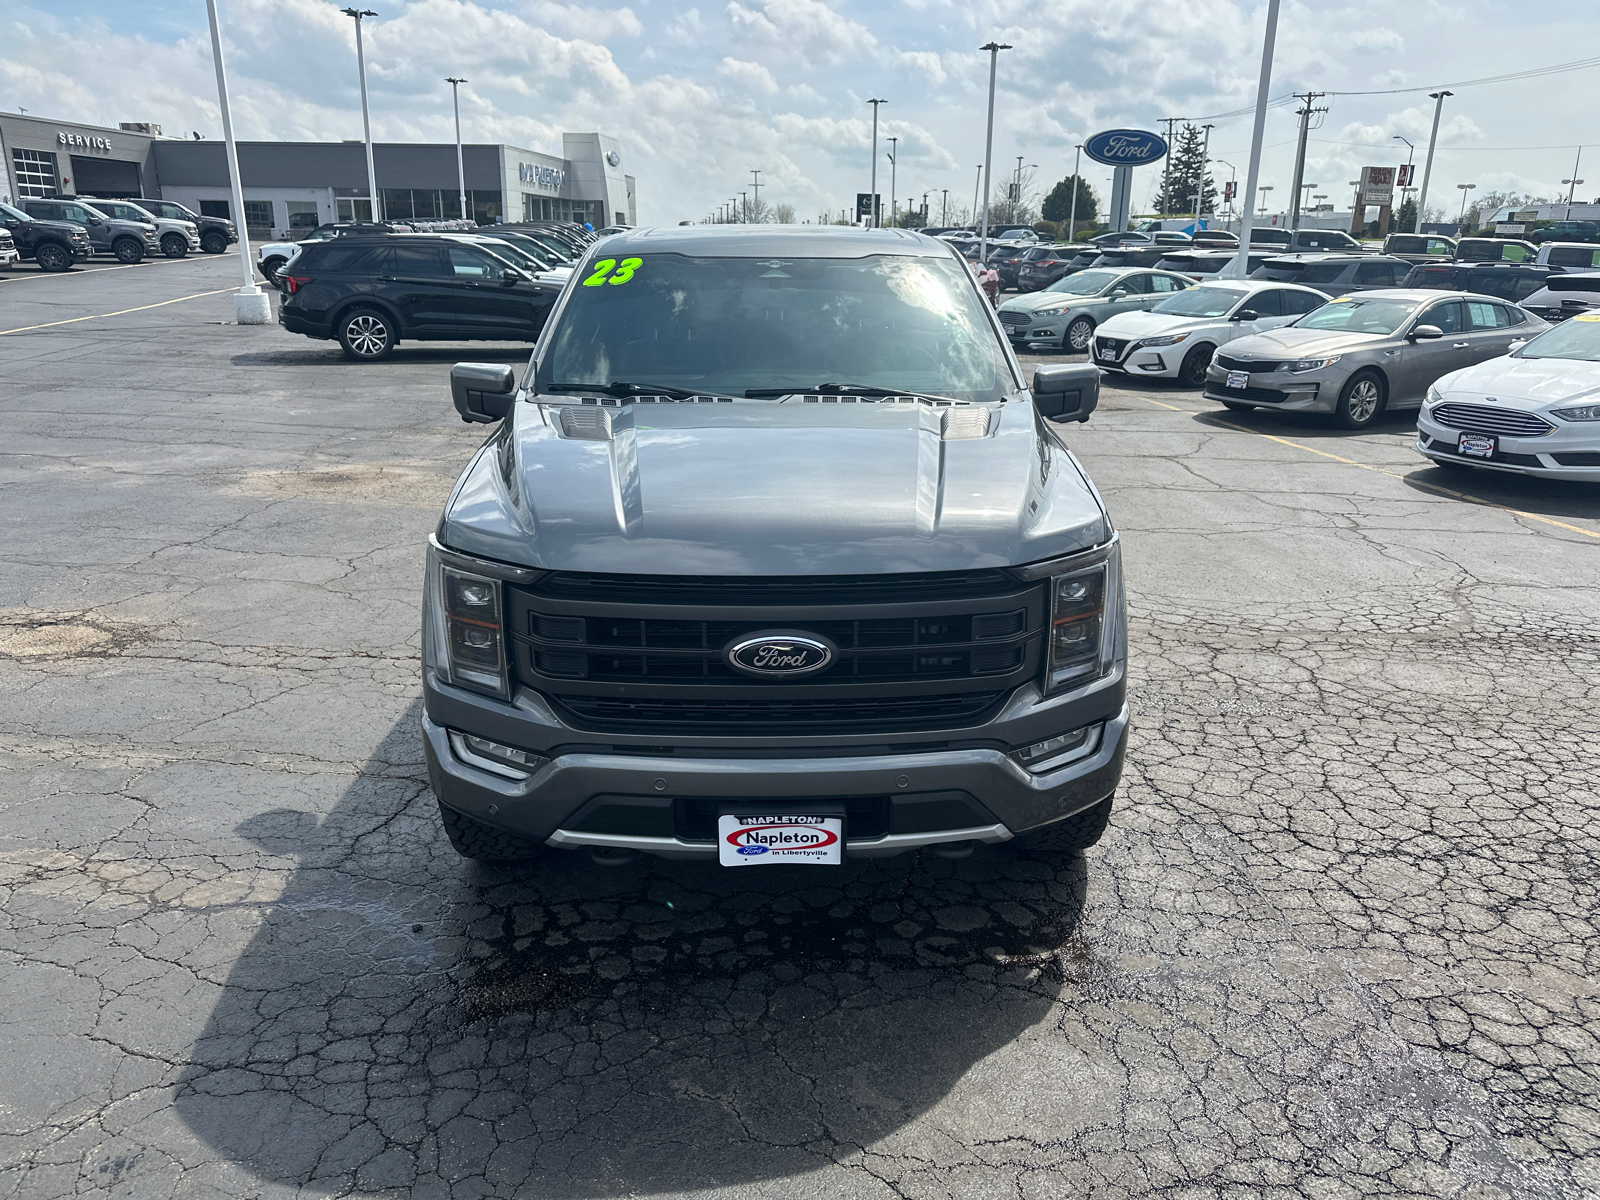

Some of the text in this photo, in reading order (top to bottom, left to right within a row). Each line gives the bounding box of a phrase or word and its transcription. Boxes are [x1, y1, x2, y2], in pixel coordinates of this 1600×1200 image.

[59, 132, 112, 150] SERVICE
[1103, 135, 1152, 158] Ford
[519, 162, 566, 188] NAPLETON
[583, 257, 643, 287] 23
[753, 645, 808, 667] Ford
[747, 816, 817, 824] NAPLETON
[746, 832, 819, 846] Napleton
